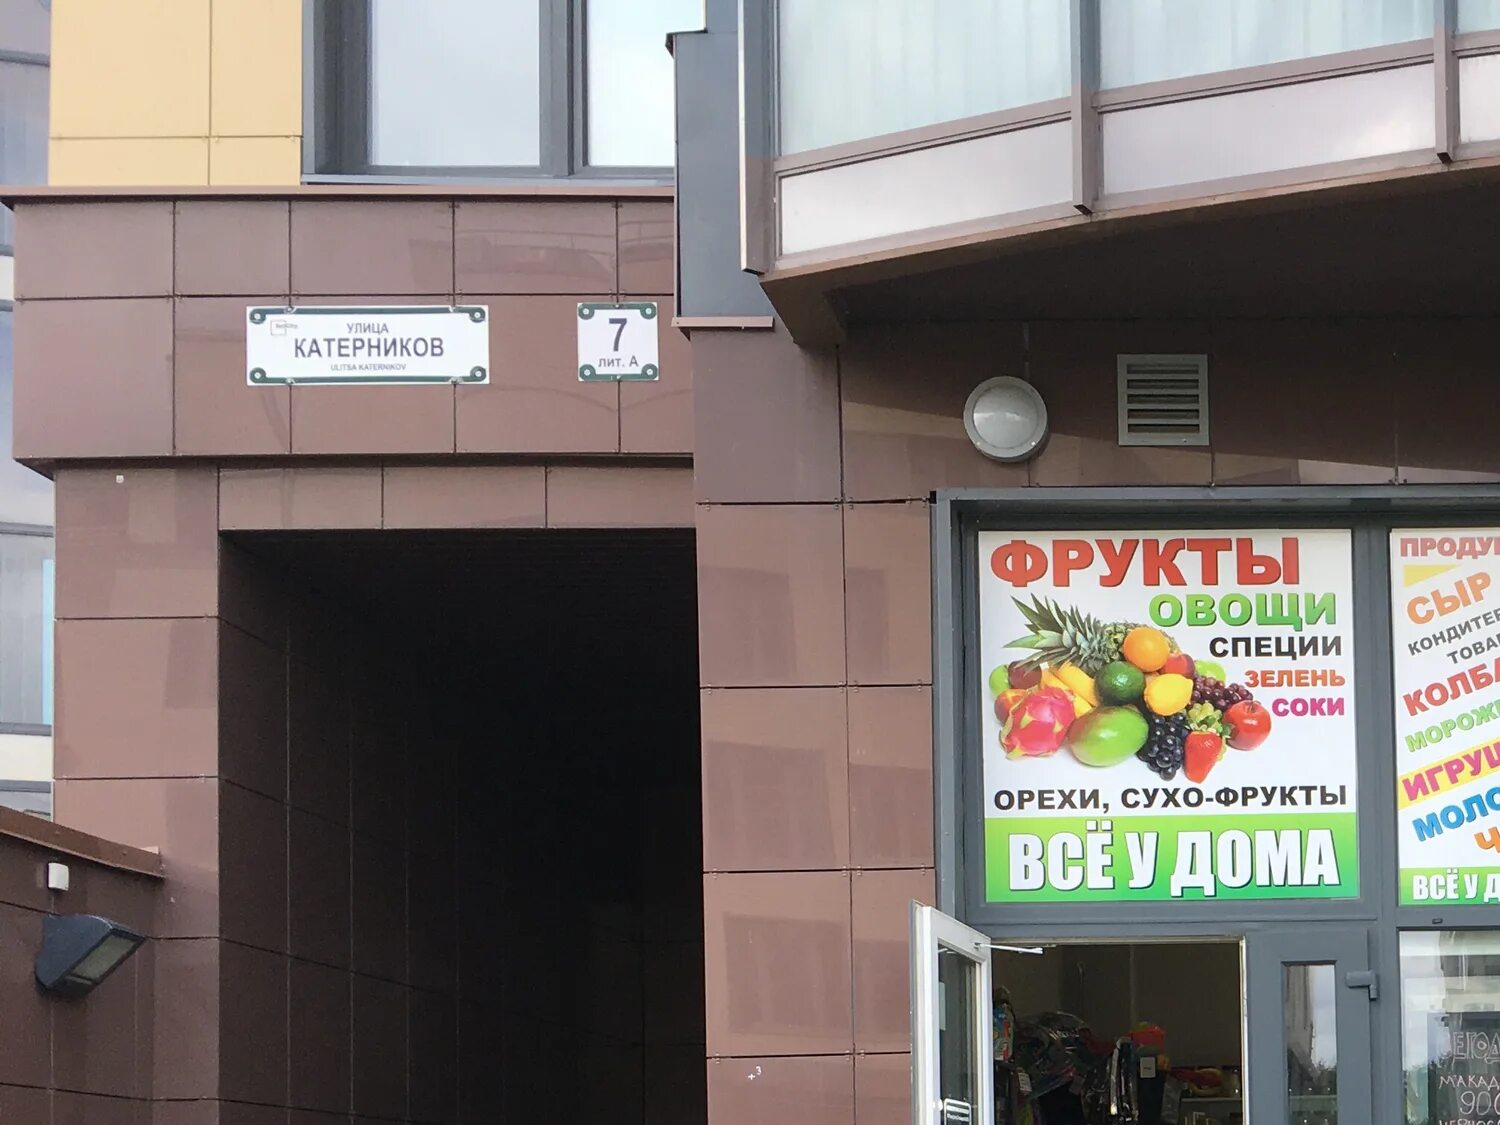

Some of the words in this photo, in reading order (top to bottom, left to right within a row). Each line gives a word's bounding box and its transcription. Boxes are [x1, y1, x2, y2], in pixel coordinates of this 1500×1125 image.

[346, 323, 389, 335] УЛИЦА
[608, 318, 628, 352] 7
[294, 337, 445, 358] КАТЕРНИКОВ
[330, 363, 357, 371] ULITSA
[358, 363, 407, 371] KATERNIKOV
[598, 358, 625, 368] лит.
[629, 355, 639, 368] А
[990, 537, 1300, 588] ФРУКТЫ
[1148, 592, 1337, 631] ОВОЩИ
[1406, 571, 1492, 625] СЫР
[1209, 636, 1343, 661] СПЕЦИИ
[1244, 669, 1346, 688] ЗЕЛЕНЬ
[1271, 697, 1345, 717] СОКИ
[993, 788, 1110, 814] ОРЕХИ,
[1120, 784, 1347, 810] СУХО-ФРУКТЫ
[1008, 819, 1115, 892] ВСЁ
[1124, 831, 1159, 889] У
[1170, 828, 1342, 898] ДОМА
[1412, 868, 1459, 900] ВСЁ
[1463, 874, 1479, 899] У
